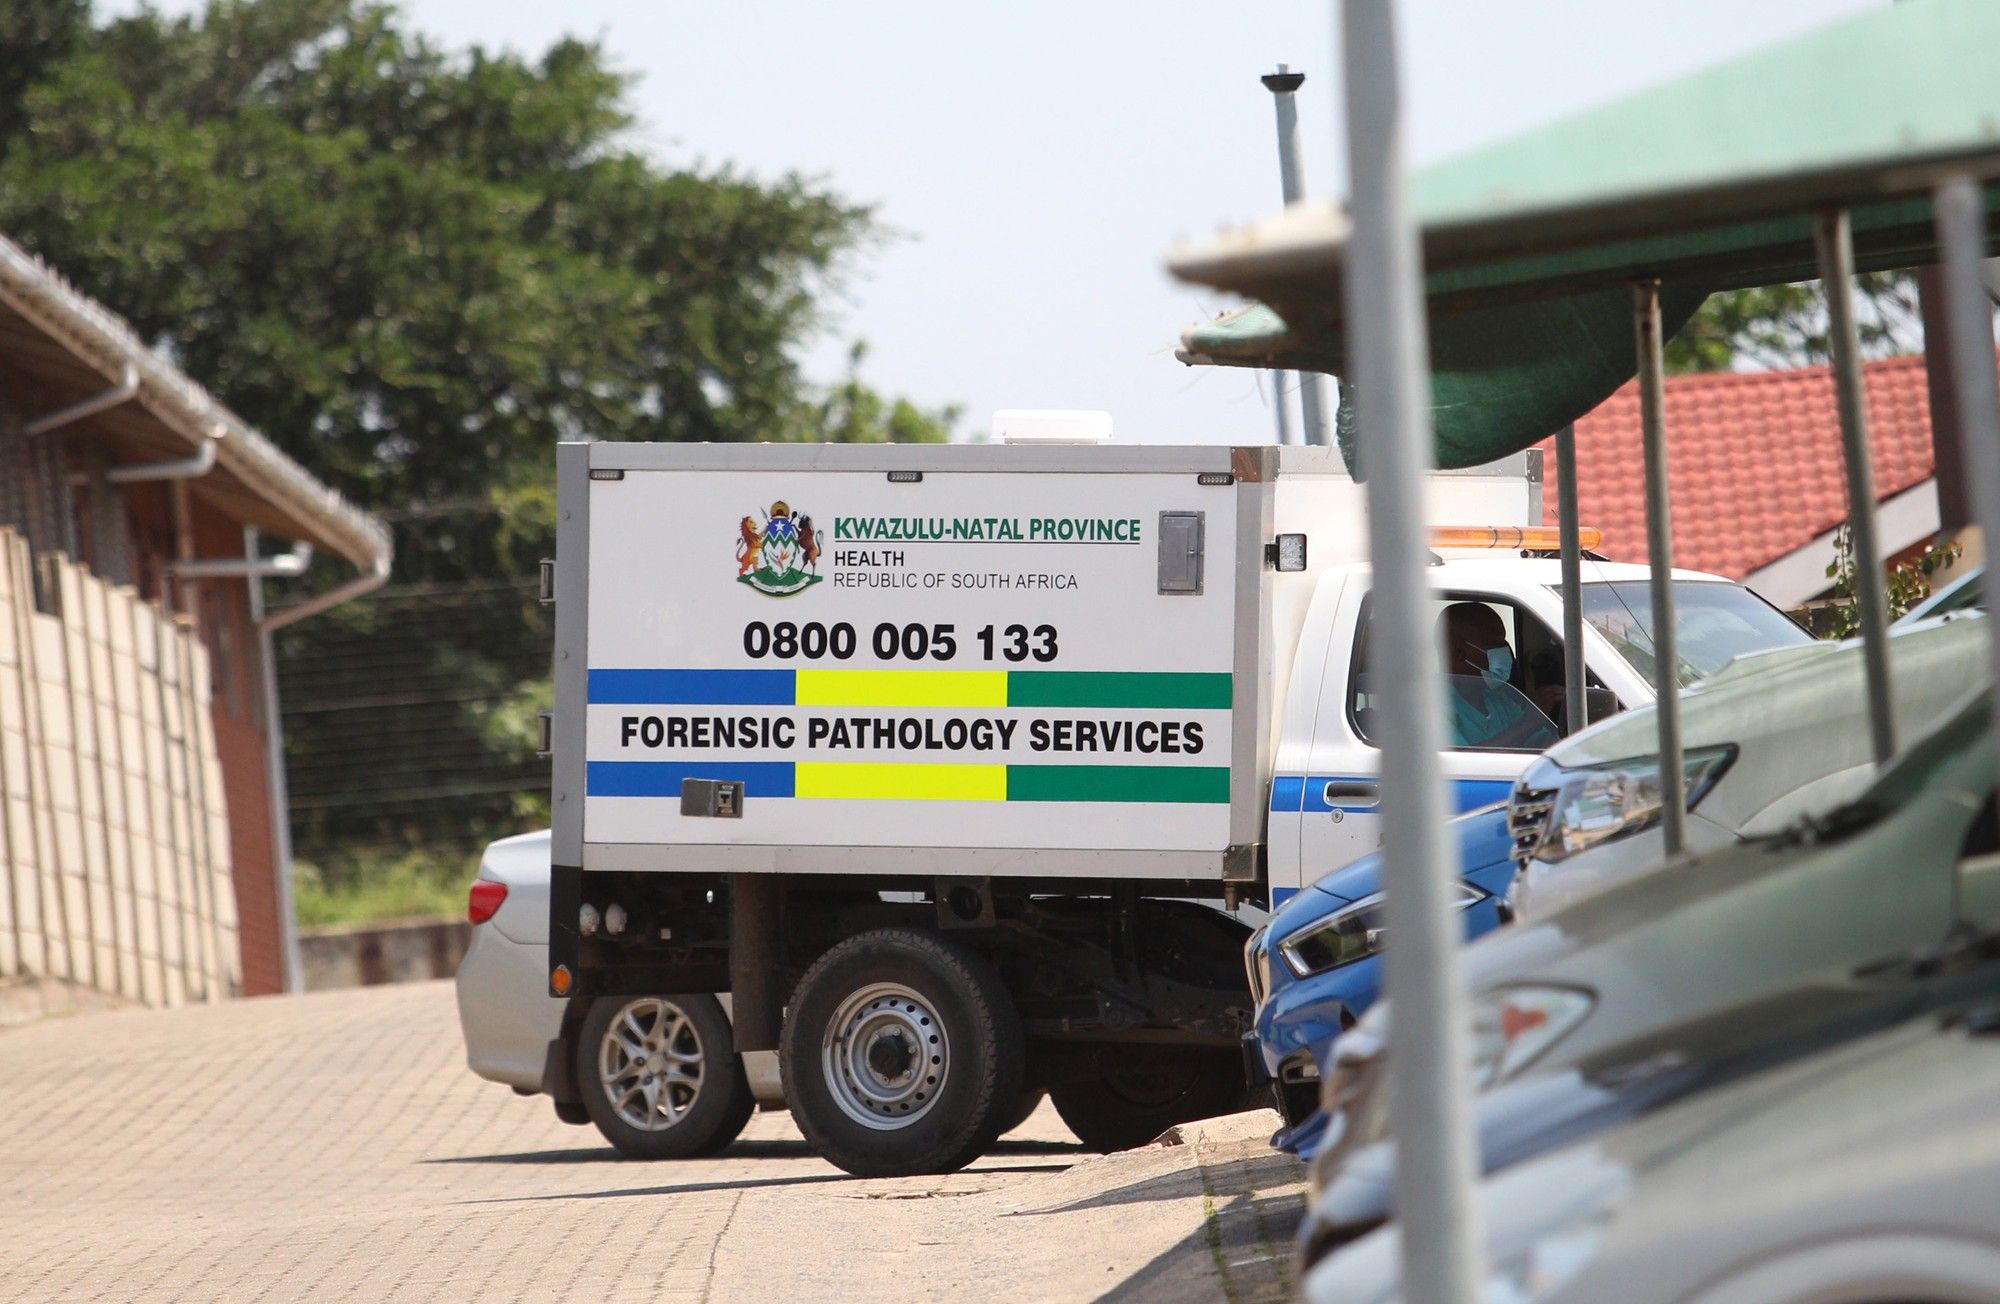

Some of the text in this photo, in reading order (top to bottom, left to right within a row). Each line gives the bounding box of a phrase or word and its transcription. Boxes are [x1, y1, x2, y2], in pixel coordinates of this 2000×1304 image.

[834, 517, 1141, 541] KWAZULU-NATAL PROVINCE
[834, 550, 905, 567] HEALTH
[833, 572, 1079, 590] REPUBLIC OF SOUTH AFRICA
[743, 620, 1059, 663] 0800 005 133
[621, 715, 1205, 755] FORENSIC PATHOLOGY SERVICES
